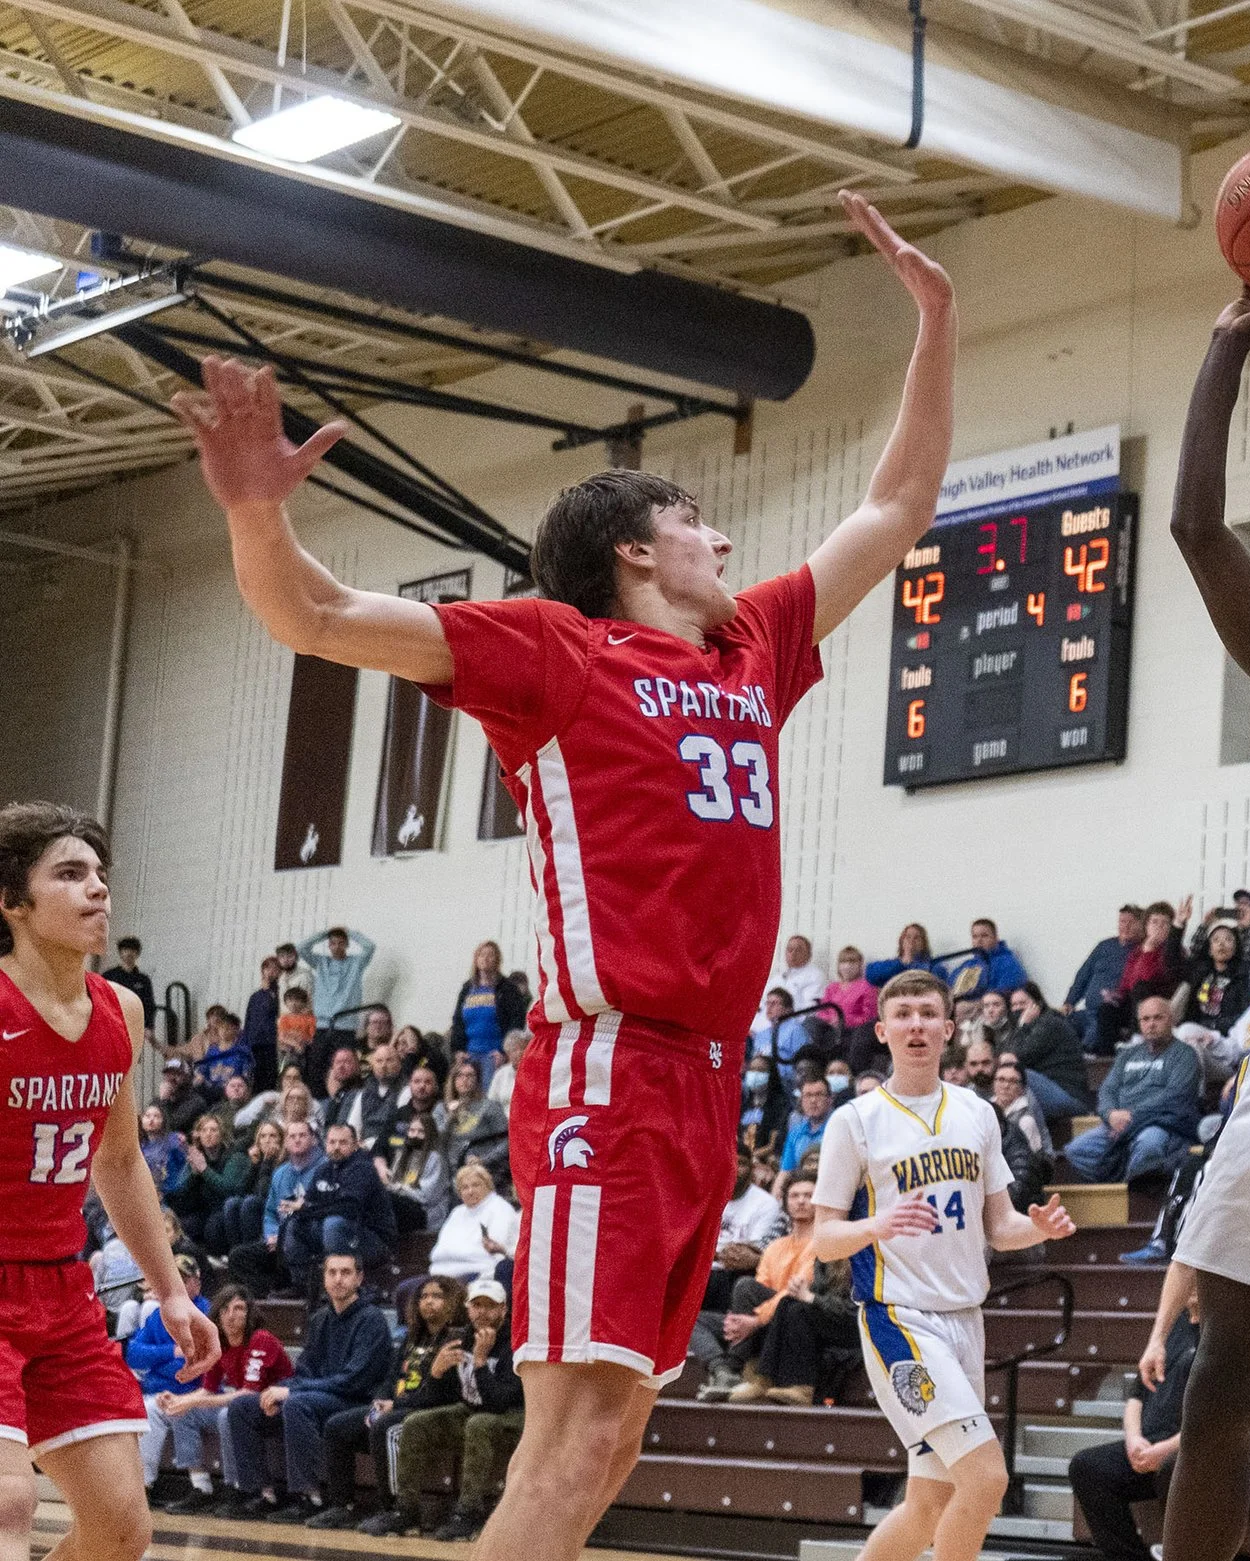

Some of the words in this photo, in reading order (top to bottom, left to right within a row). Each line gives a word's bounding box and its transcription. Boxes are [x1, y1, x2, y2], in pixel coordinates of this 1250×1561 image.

[940, 478, 967, 501] high
[969, 471, 1007, 490] Valley
[1010, 457, 1054, 483] Health
[1056, 443, 1114, 472] Network
[1061, 506, 1110, 536] Guests
[1064, 537, 1110, 593] 42
[902, 571, 945, 625] 42
[976, 601, 1019, 635] period
[1027, 592, 1046, 627] 4
[973, 651, 1017, 680] player
[1061, 635, 1095, 663] fouls
[900, 664, 932, 691] fouls
[1068, 672, 1088, 713] 6
[633, 676, 773, 728] SPARTANS
[907, 699, 926, 739] 6
[973, 738, 1007, 766] game
[1060, 726, 1088, 749] won
[678, 733, 775, 831] 33
[898, 752, 924, 773] won
[7, 1072, 124, 1112] SPARTANS
[29, 1120, 95, 1184] 12
[891, 1147, 981, 1194] WARRIORS
